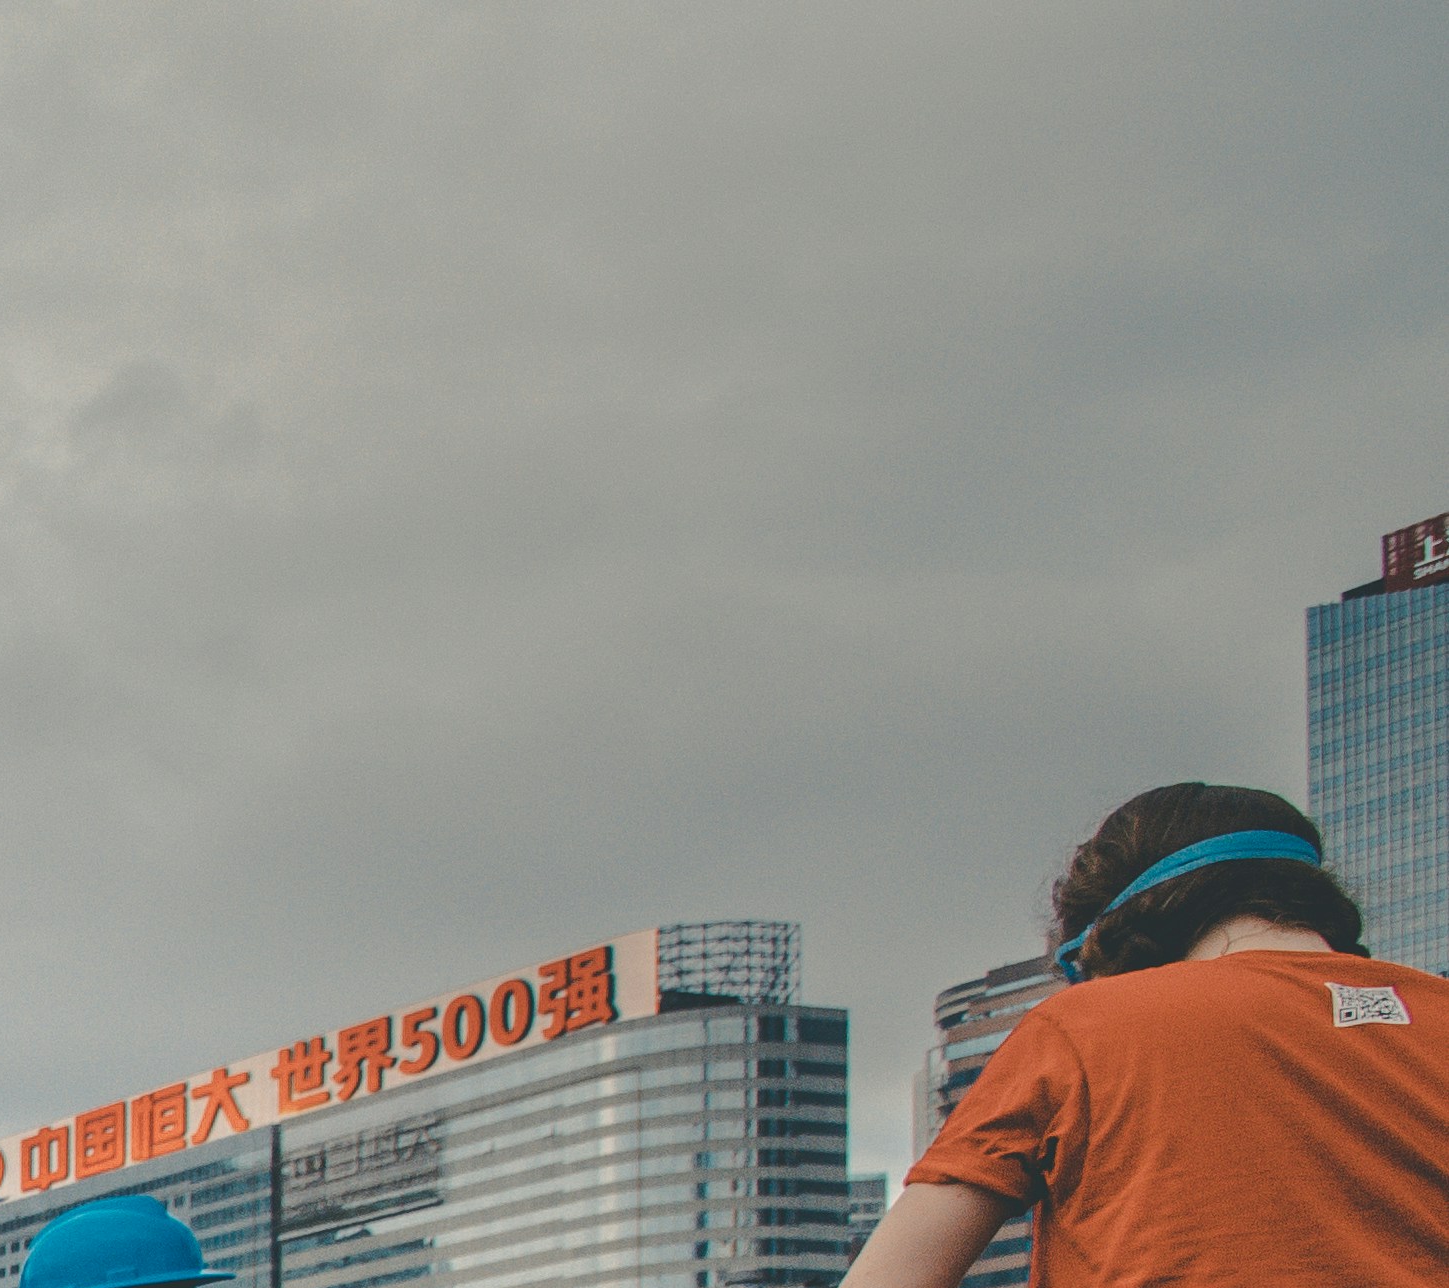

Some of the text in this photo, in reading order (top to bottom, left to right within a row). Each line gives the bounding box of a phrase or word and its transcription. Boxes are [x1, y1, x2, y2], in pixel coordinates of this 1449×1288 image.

[20, 1067, 250, 1194] 中国恒大
[270, 944, 615, 1115] 世界500强
